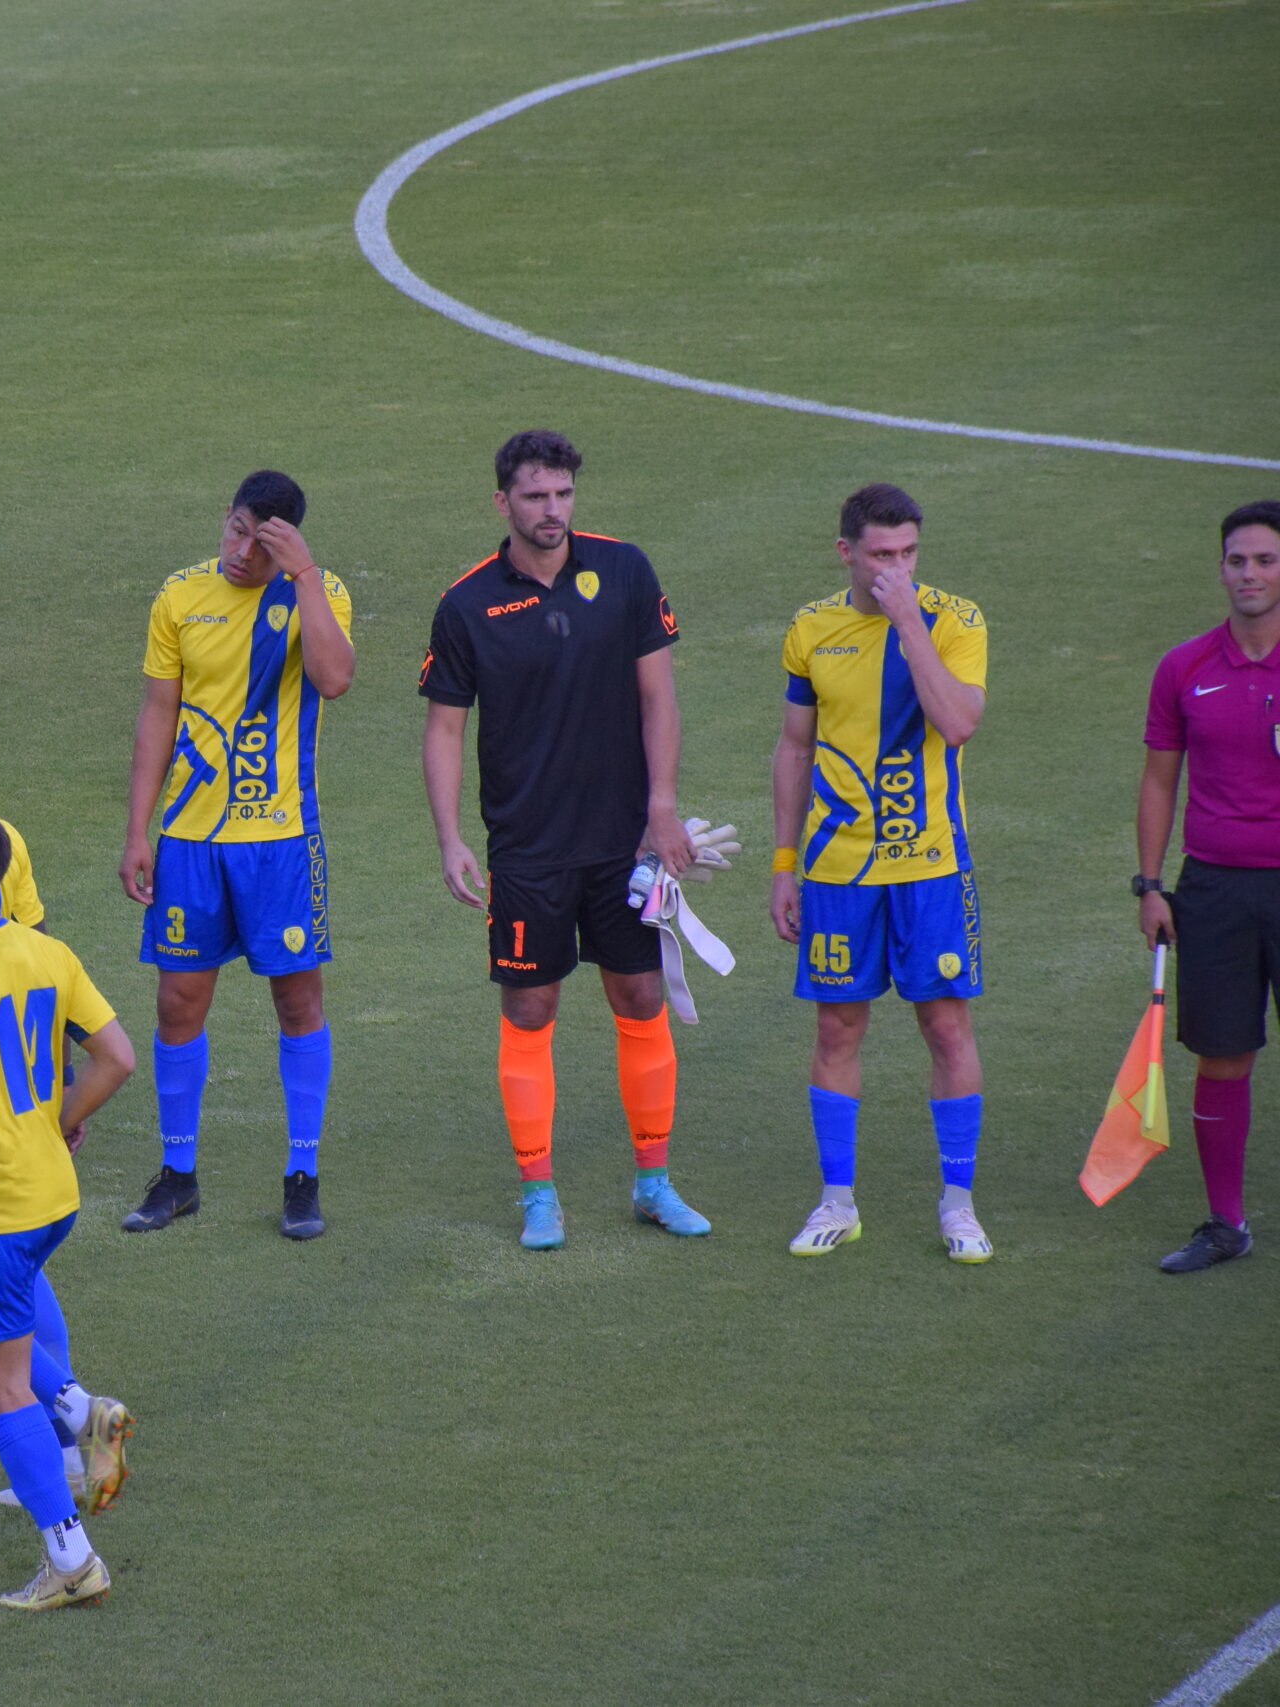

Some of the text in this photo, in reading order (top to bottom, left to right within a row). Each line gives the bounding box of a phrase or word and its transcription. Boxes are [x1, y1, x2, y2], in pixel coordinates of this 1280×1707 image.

[486, 596, 540, 617] GIVOVA
[184, 614, 228, 624] GIVOVA
[815, 646, 859, 655] GIVOVA
[235, 710, 268, 801] 1926
[880, 749, 917, 840] 1926
[166, 906, 185, 944] 3
[512, 920, 525, 958] 1
[156, 944, 199, 956] GIVOVA
[810, 933, 850, 973] 45
[497, 959, 537, 970] GIVOVA
[809, 973, 854, 984] GIVOVA
